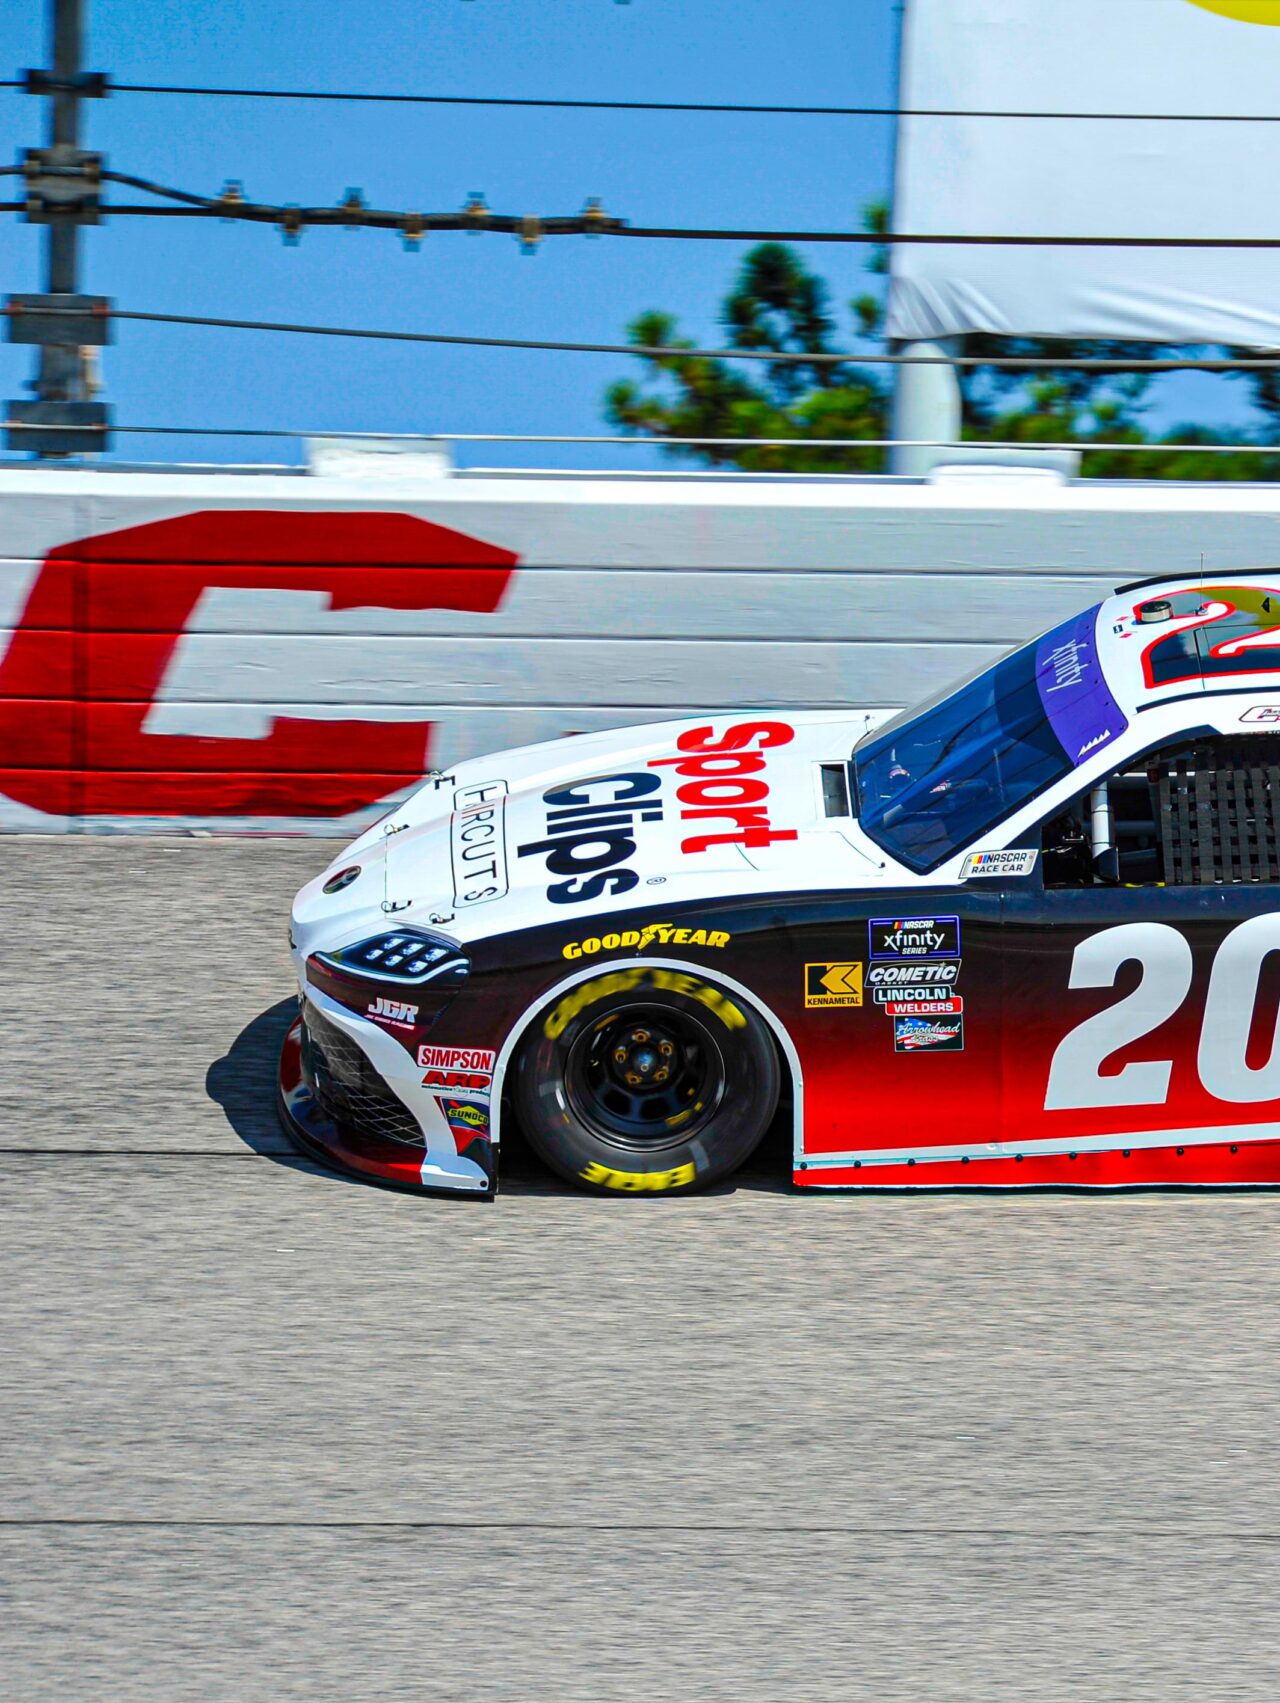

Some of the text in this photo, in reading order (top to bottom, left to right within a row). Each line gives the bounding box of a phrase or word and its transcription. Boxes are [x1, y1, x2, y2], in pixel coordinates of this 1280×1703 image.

[1042, 639, 1088, 692] xfinity
[647, 721, 798, 854] Sport
[461, 785, 498, 901] HIRCUTS
[517, 772, 664, 904] Clips
[986, 852, 1028, 864] NASCAR
[971, 864, 1024, 874] RACE CAR
[903, 920, 935, 929] NASCAR
[562, 923, 732, 960] GOODYEAR
[884, 930, 945, 950] xfinity
[902, 947, 927, 955] SERIES
[869, 965, 957, 982] COMETIC
[807, 997, 861, 1006] KENNAMETAL
[878, 988, 947, 1002] LINCOLN
[368, 997, 419, 1023] JGR
[894, 1003, 954, 1013] WELDERS
[421, 1047, 492, 1071] SIMPSON
[421, 1070, 491, 1089] ARP
[450, 1110, 489, 1124] SUNOCO
